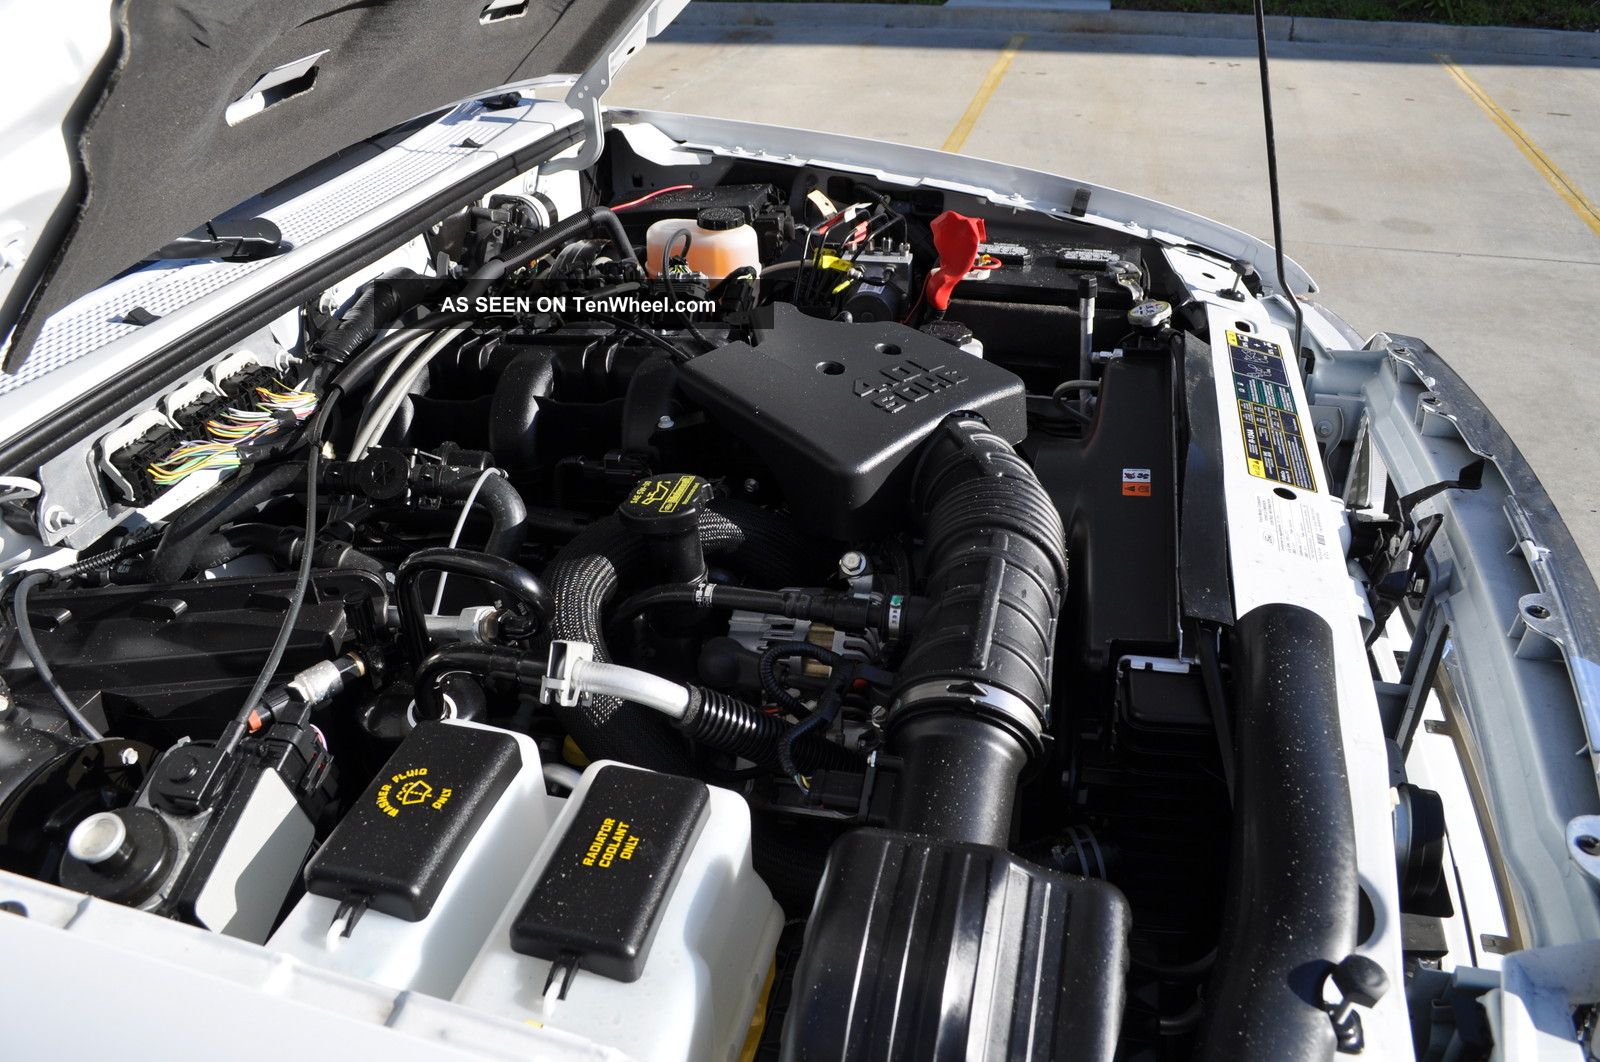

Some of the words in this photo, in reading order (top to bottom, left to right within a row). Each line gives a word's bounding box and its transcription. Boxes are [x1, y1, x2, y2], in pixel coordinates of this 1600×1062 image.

[376, 784, 399, 817] WASHER
[392, 768, 428, 783] FLUID
[431, 788, 452, 810] ONLY
[582, 818, 616, 866] RADIATOR
[598, 821, 630, 868] COOLANT
[619, 835, 640, 860] ONLY
